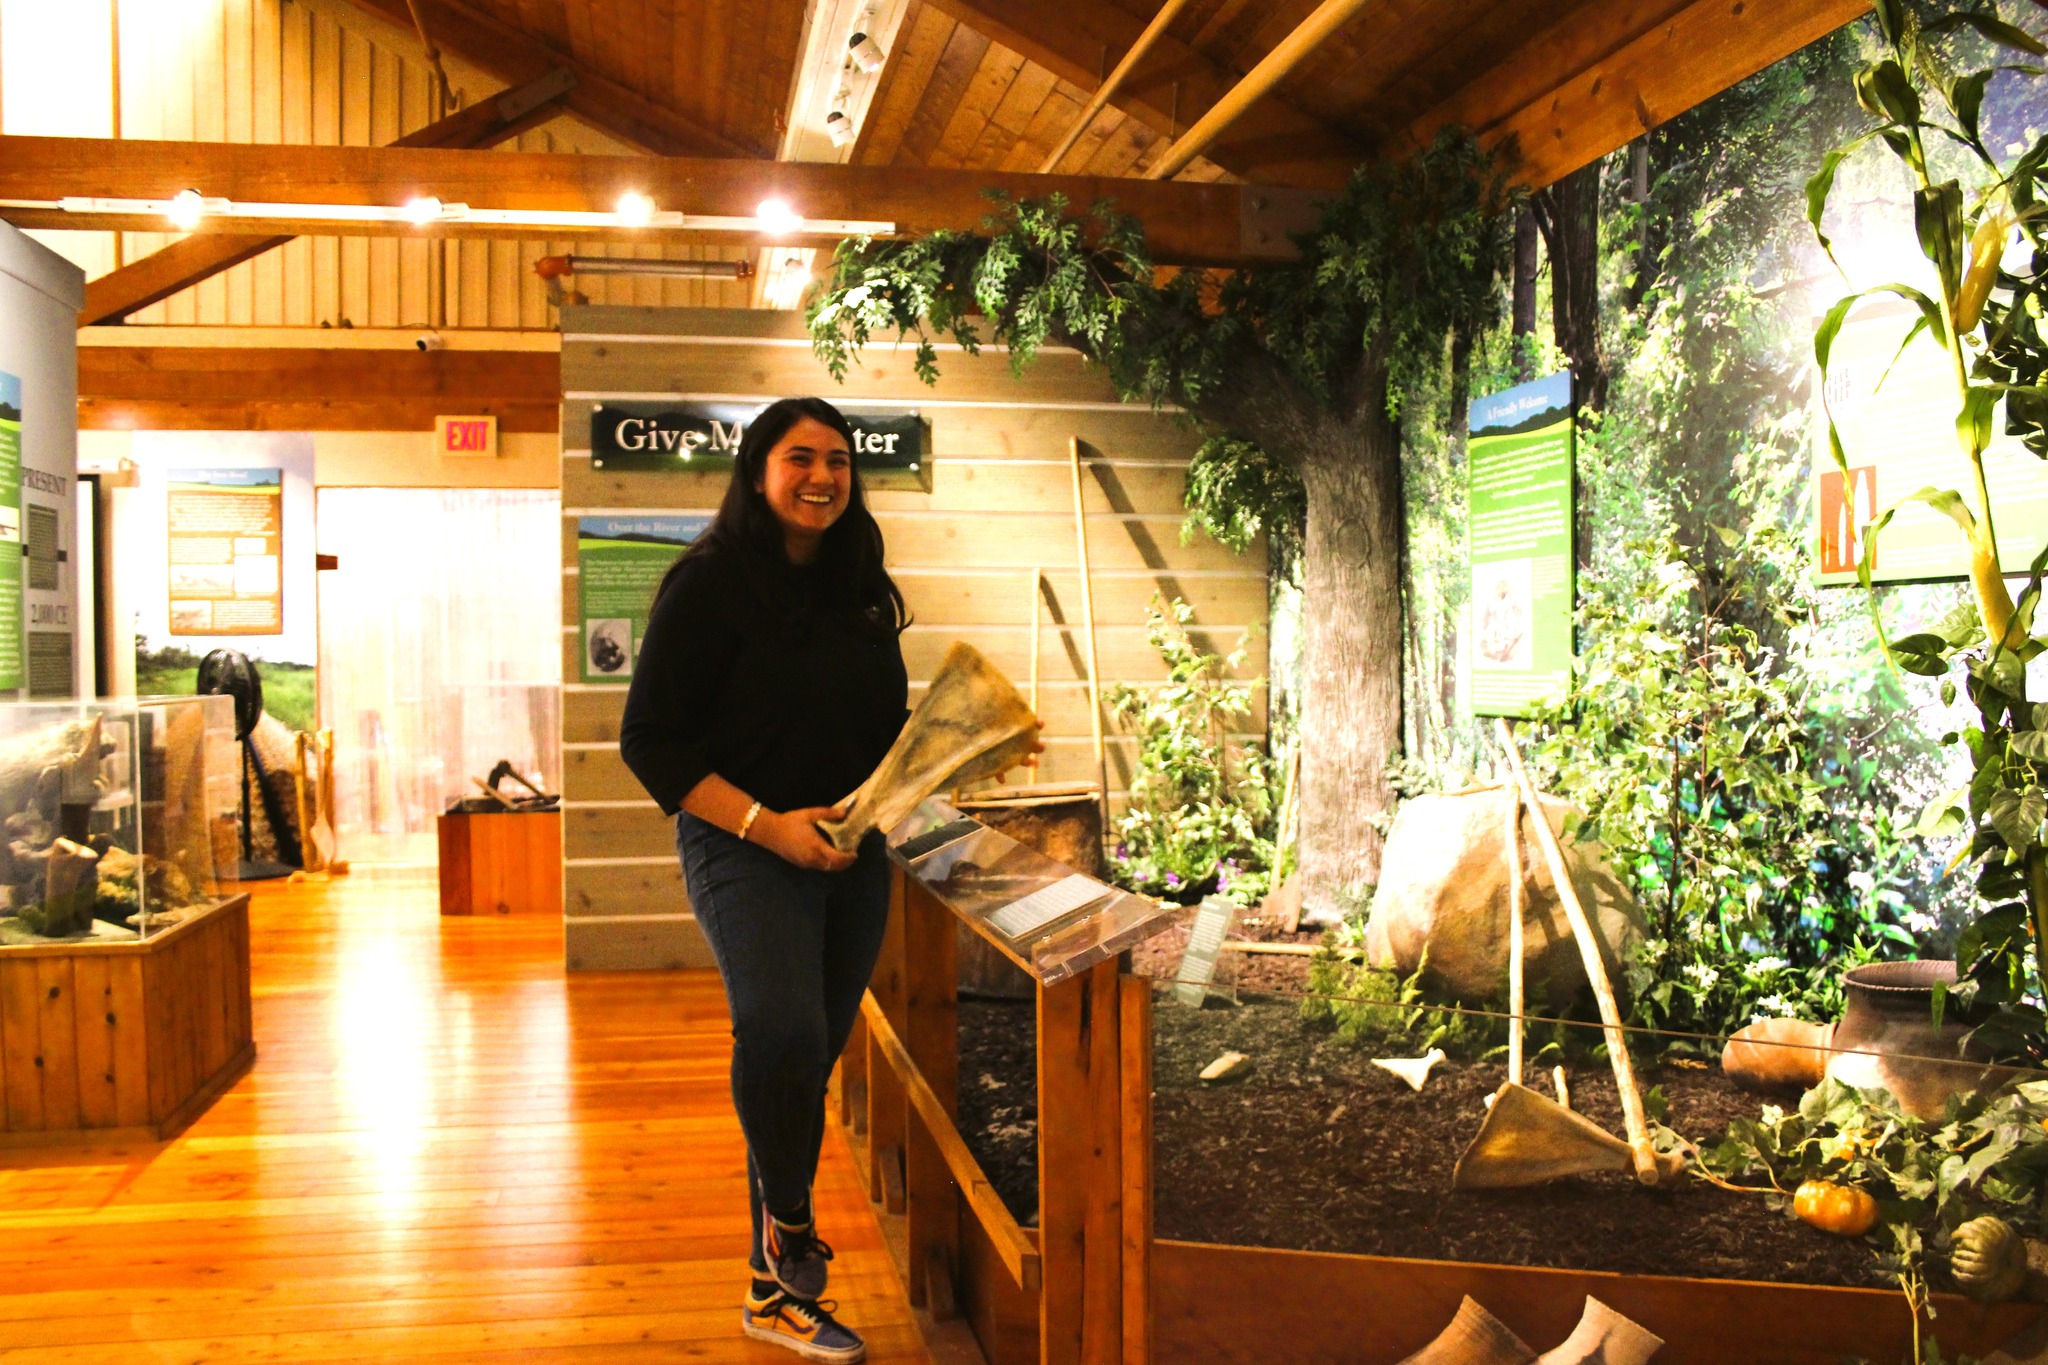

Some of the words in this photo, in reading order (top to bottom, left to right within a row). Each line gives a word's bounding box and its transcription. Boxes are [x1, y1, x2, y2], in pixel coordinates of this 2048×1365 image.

[446, 421, 488, 451] EXIT
[614, 418, 698, 451] Give
[709, 420, 743, 451] M
[847, 421, 900, 454] ter
[22, 466, 67, 497] PRESENT
[634, 522, 651, 532] the
